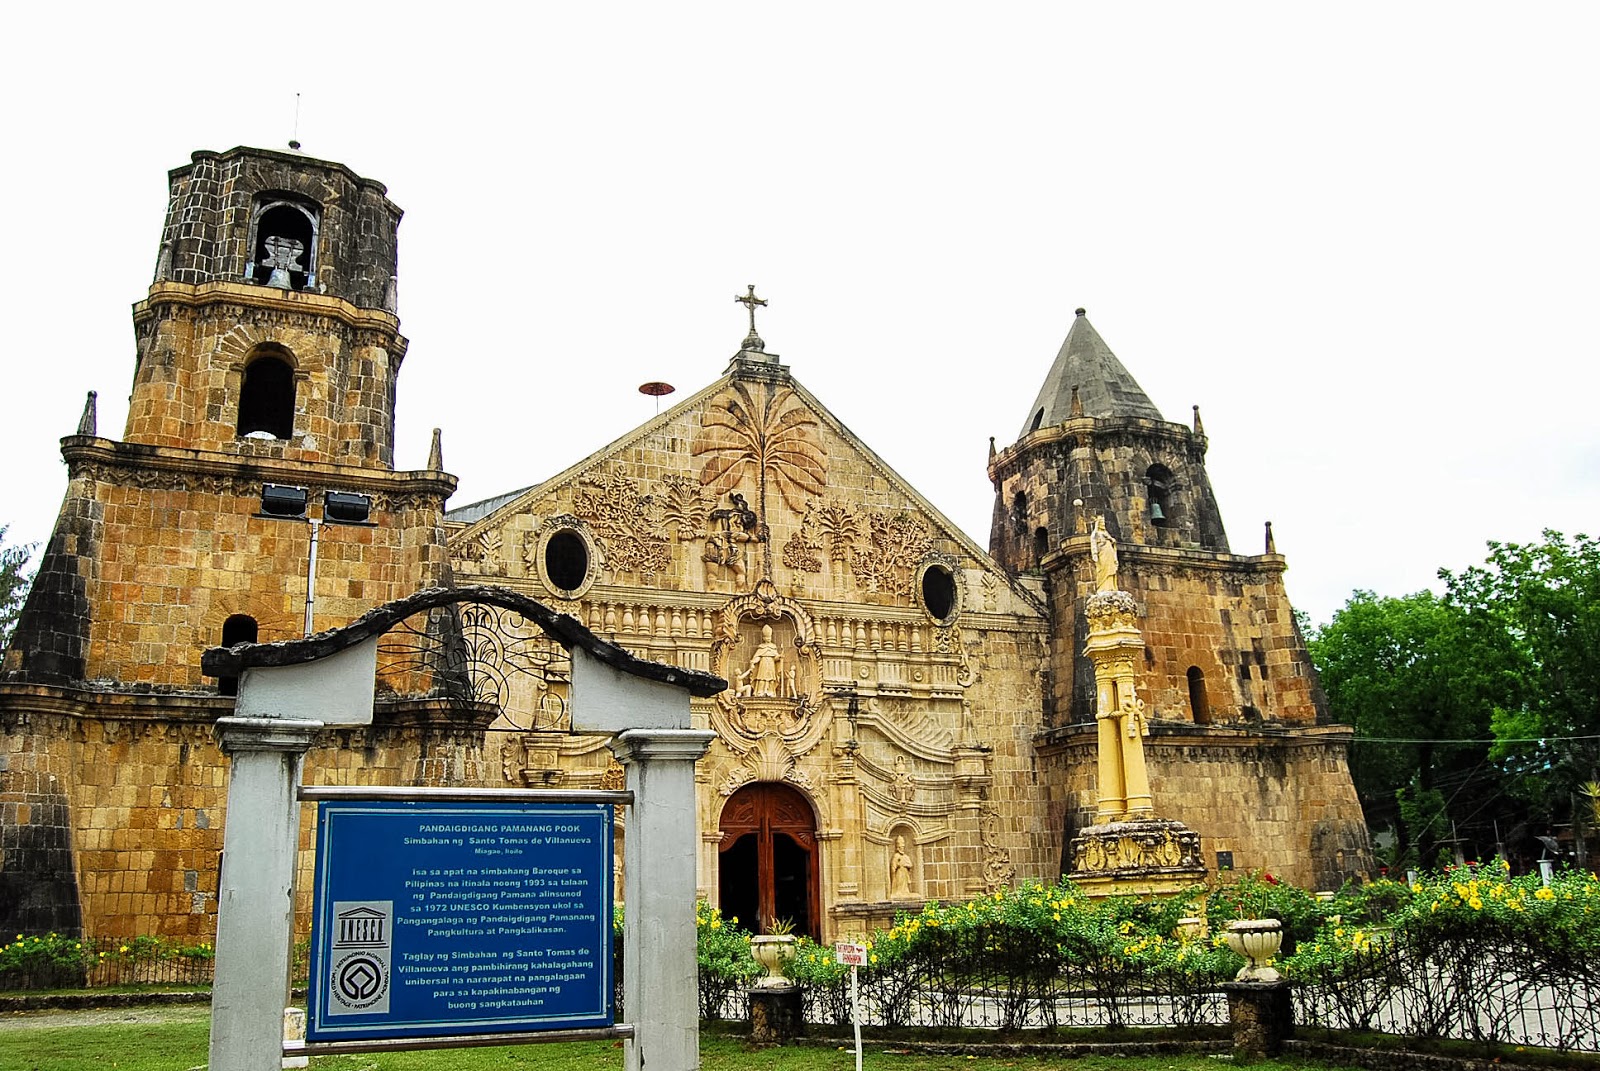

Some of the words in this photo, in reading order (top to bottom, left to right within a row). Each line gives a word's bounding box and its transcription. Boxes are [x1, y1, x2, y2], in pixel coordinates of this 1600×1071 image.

[403, 837, 450, 845] Simbahan
[452, 838, 463, 846] ng
[443, 869, 464, 877] apat
[481, 868, 530, 876] simbahang
[532, 867, 569, 876] Baroque
[405, 880, 445, 889] Pilipinas
[493, 880, 521, 888] noong
[413, 892, 425, 900] ng
[430, 891, 498, 900] Pandaigdigang
[539, 890, 581, 898] alinsunod
[425, 904, 447, 912] 1972
[450, 903, 490, 911] UNESCO
[492, 903, 550, 911] Kumbensyon
[397, 916, 464, 925] Pangangalaga
[480, 915, 547, 924] Pandaigdigang
[549, 914, 595, 922] Pamanang
[341, 919, 382, 941] UNESCO
[428, 928, 484, 938] Pangkultura
[486, 927, 496, 935] at
[499, 926, 567, 936] Pangkalikasan.
[403, 952, 434, 961] Taglay
[437, 953, 449, 961] ng
[451, 951, 497, 959] Simbahan
[502, 951, 514, 959] ng
[546, 948, 576, 956] Tomas
[398, 965, 449, 973] Villanueva
[451, 965, 469, 974] ang
[471, 963, 529, 972] pambihirang
[531, 961, 593, 970] kahalagahang
[405, 977, 450, 986] unibersal
[528, 973, 585, 982] pangalagaan
[433, 990, 455, 998] para
[471, 986, 547, 996] kapakinabangan
[549, 985, 561, 994] ng
[448, 1001, 476, 1009] buong
[479, 998, 543, 1008] sangkatauhan
